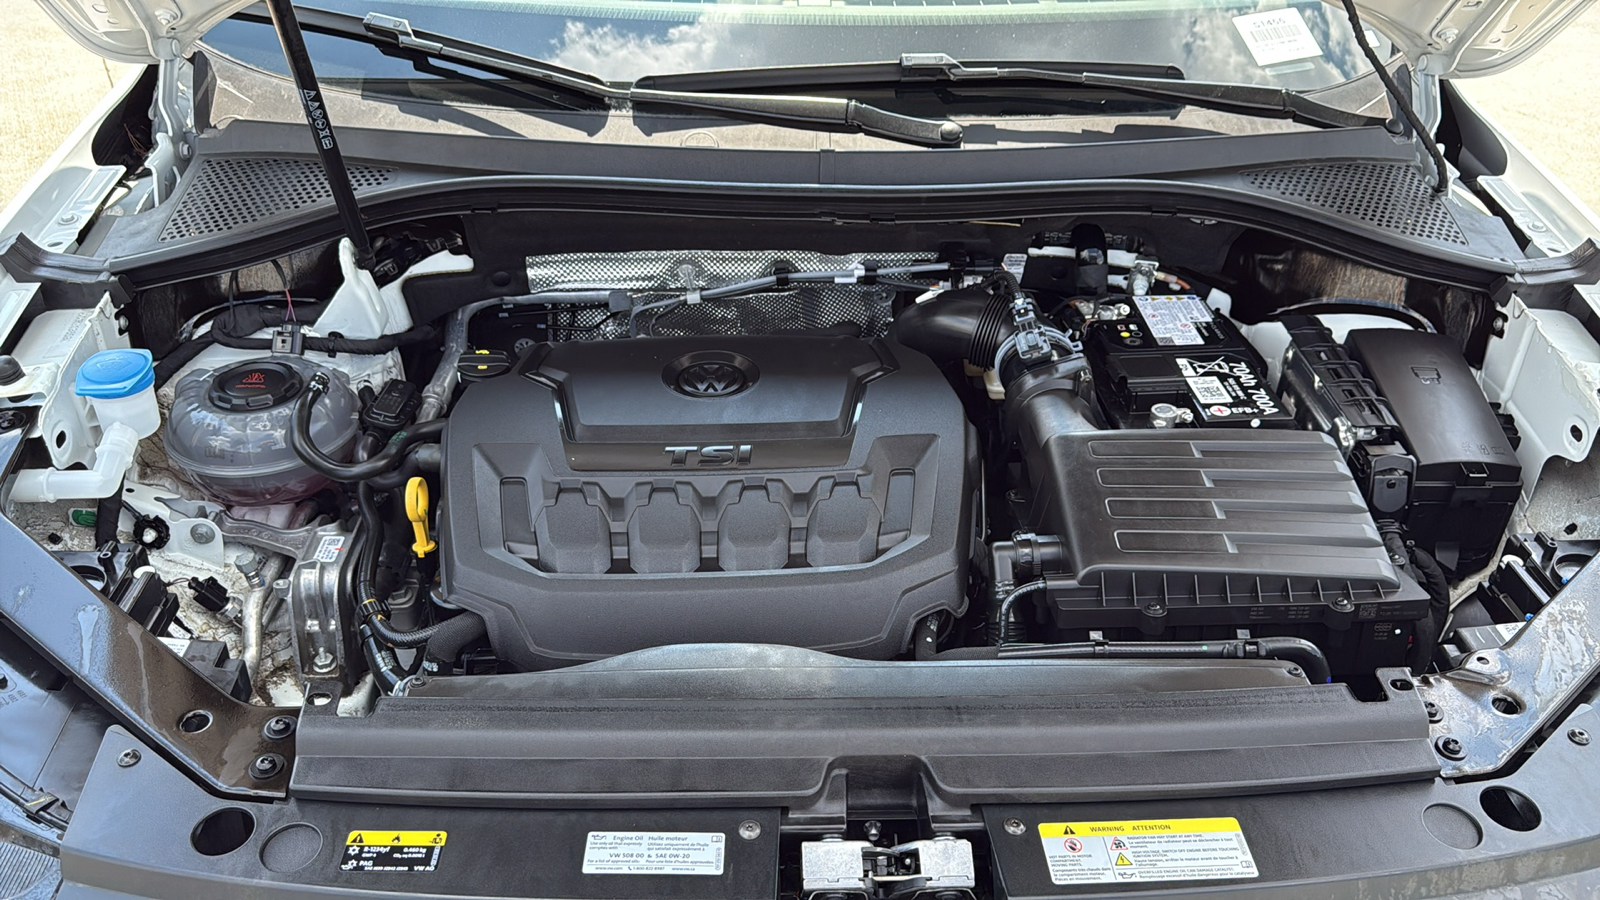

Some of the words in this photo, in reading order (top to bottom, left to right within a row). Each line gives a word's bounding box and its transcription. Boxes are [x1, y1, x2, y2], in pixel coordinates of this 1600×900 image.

[1229, 362, 1257, 386] 70Ah
[1248, 388, 1279, 415] 700A
[664, 444, 752, 466] TSI
